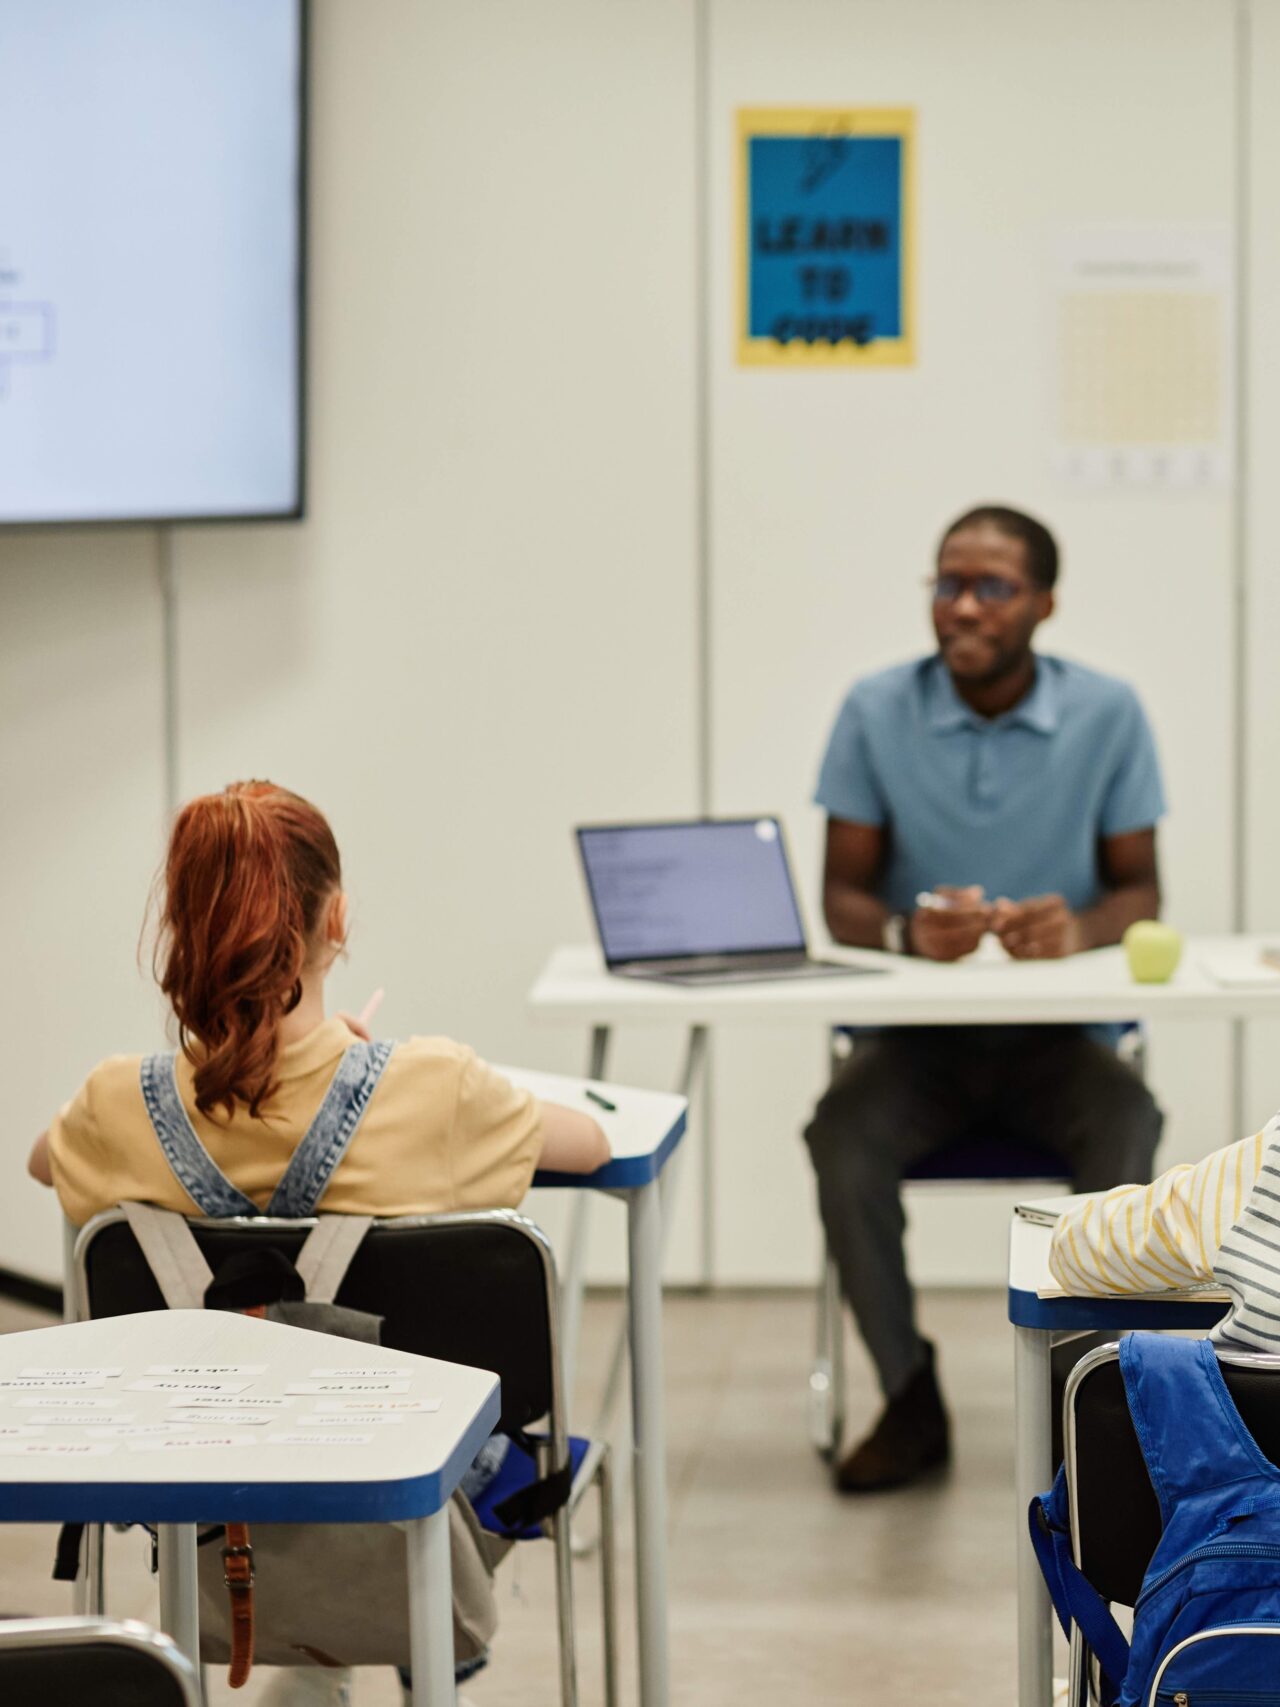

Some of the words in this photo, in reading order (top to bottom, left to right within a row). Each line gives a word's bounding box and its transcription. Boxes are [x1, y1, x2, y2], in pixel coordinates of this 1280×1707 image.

[757, 217, 888, 254] LEARN
[799, 265, 851, 302] TO
[771, 315, 872, 348] CODE
